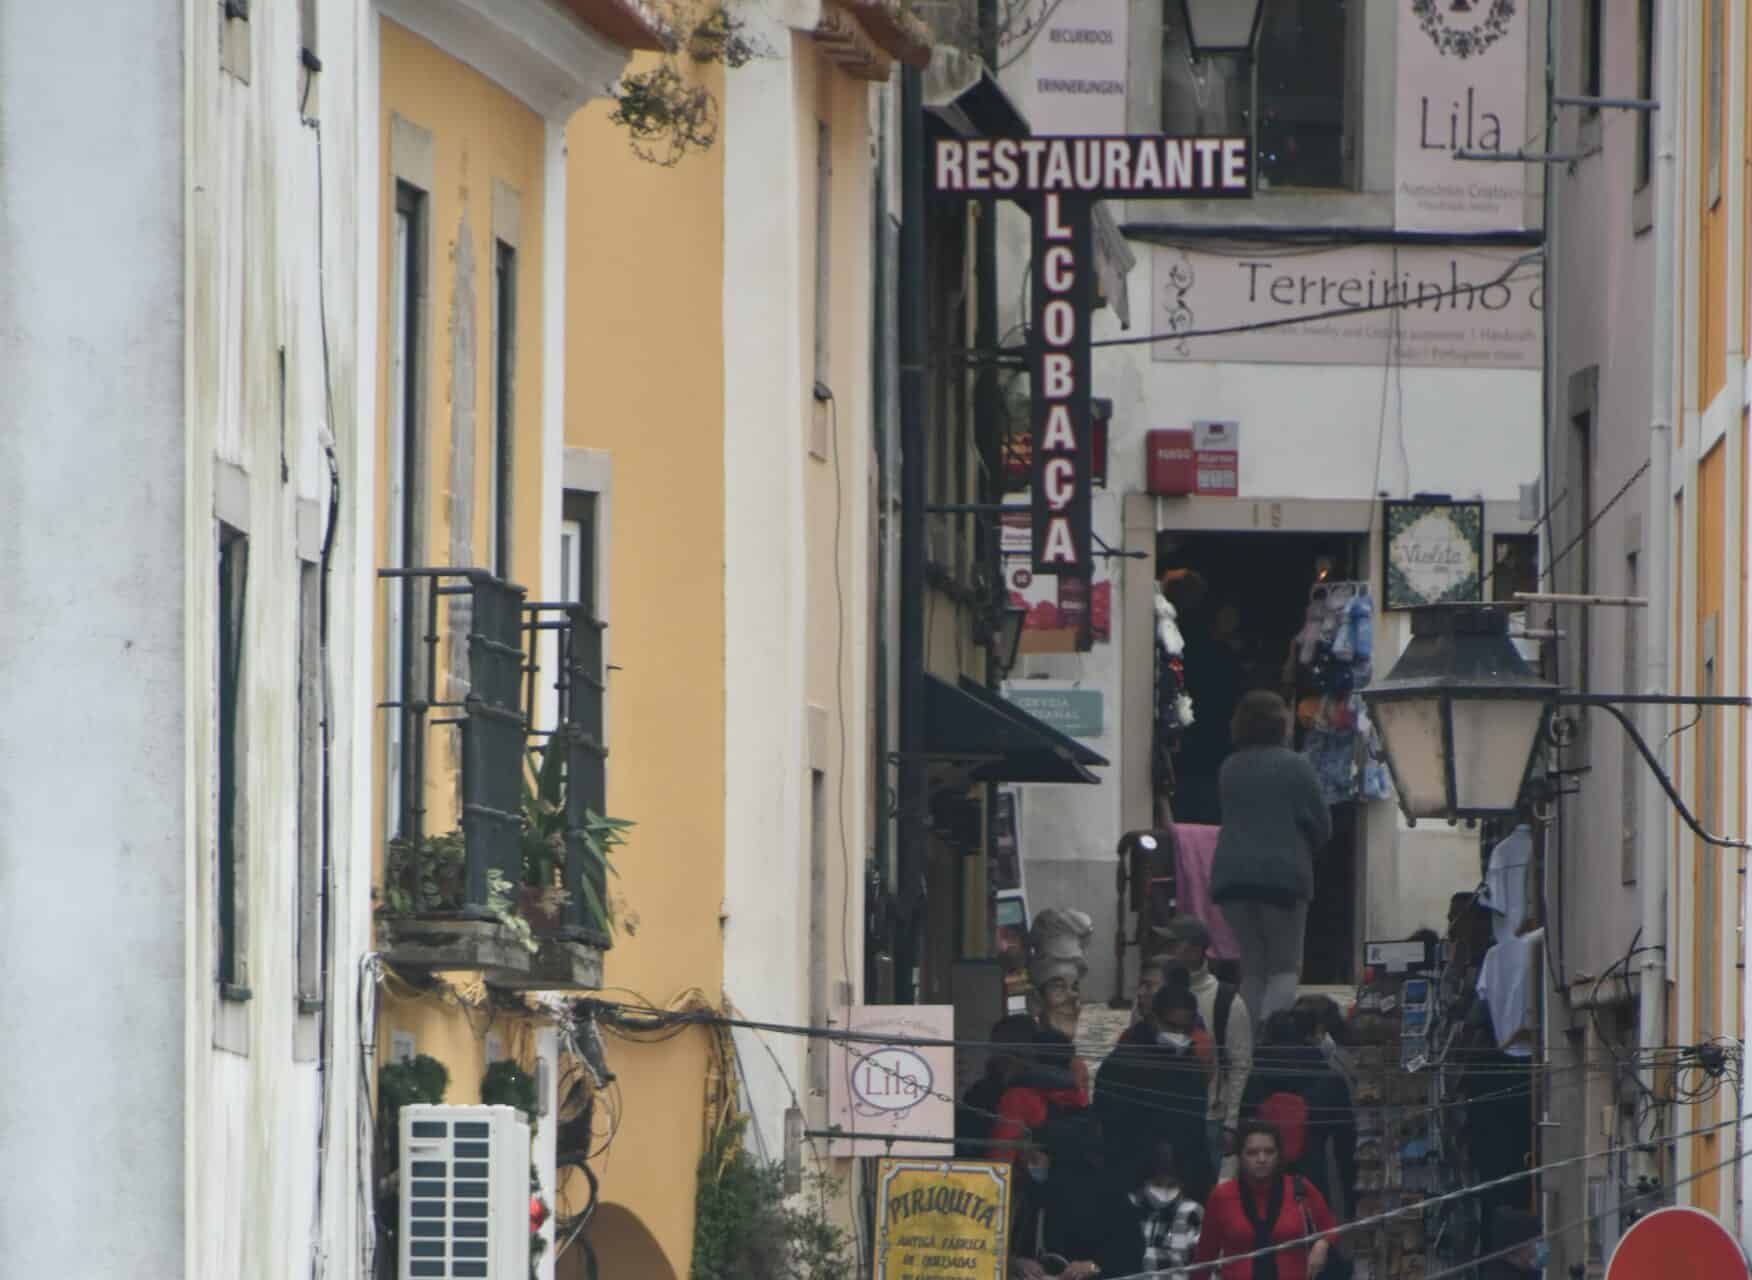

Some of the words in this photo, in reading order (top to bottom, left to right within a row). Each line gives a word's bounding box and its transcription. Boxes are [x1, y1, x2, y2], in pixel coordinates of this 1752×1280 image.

[1049, 28, 1113, 43] RECUERDOS
[1420, 85, 1501, 152] Lila
[935, 139, 1248, 191] RESTAURANTE
[1239, 259, 1512, 311] Terreirinho
[865, 1060, 919, 1098] Lila
[889, 1186, 997, 1229] PIRIQUITA
